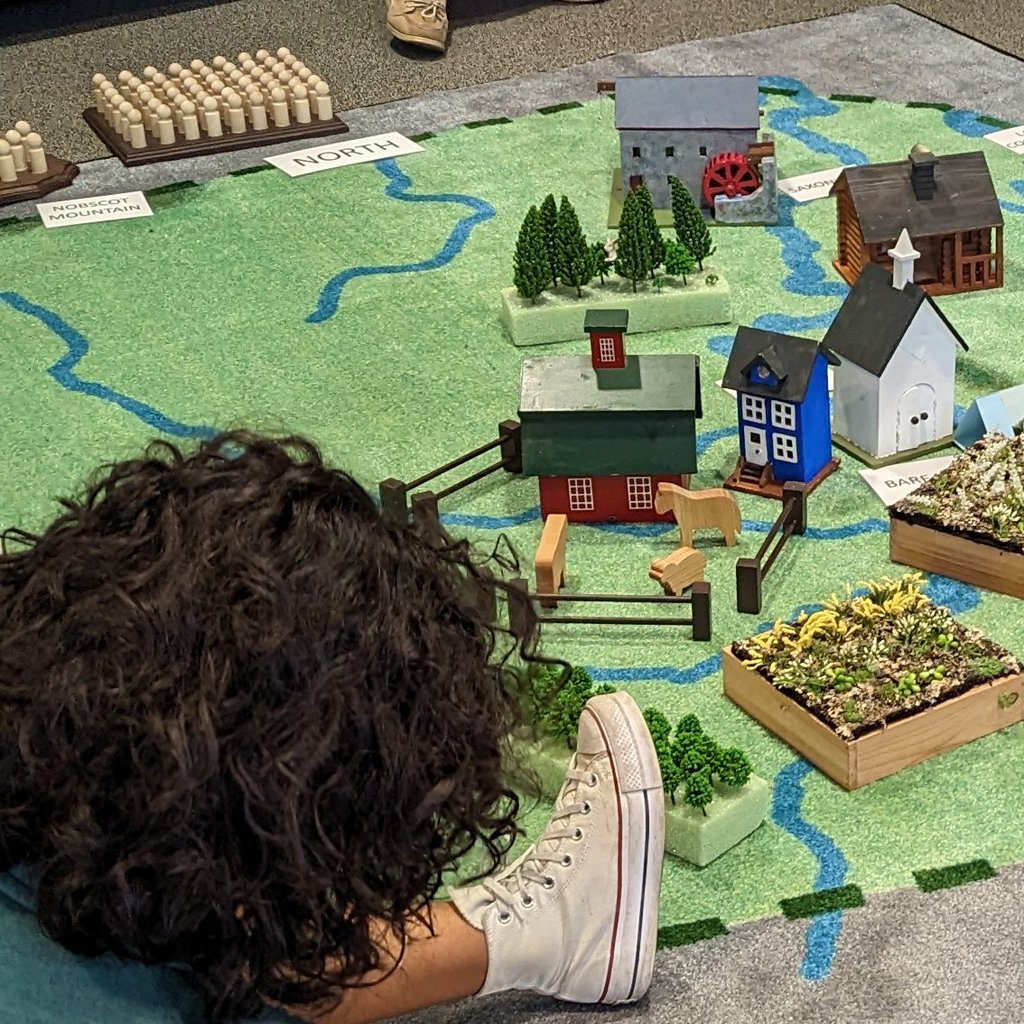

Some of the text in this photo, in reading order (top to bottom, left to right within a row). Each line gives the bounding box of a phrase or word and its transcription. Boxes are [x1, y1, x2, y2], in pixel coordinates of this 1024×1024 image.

[292, 140, 400, 167] NORTH
[48, 204, 141, 221] MOUNTAIN
[52, 197, 129, 212] NOBSCOT
